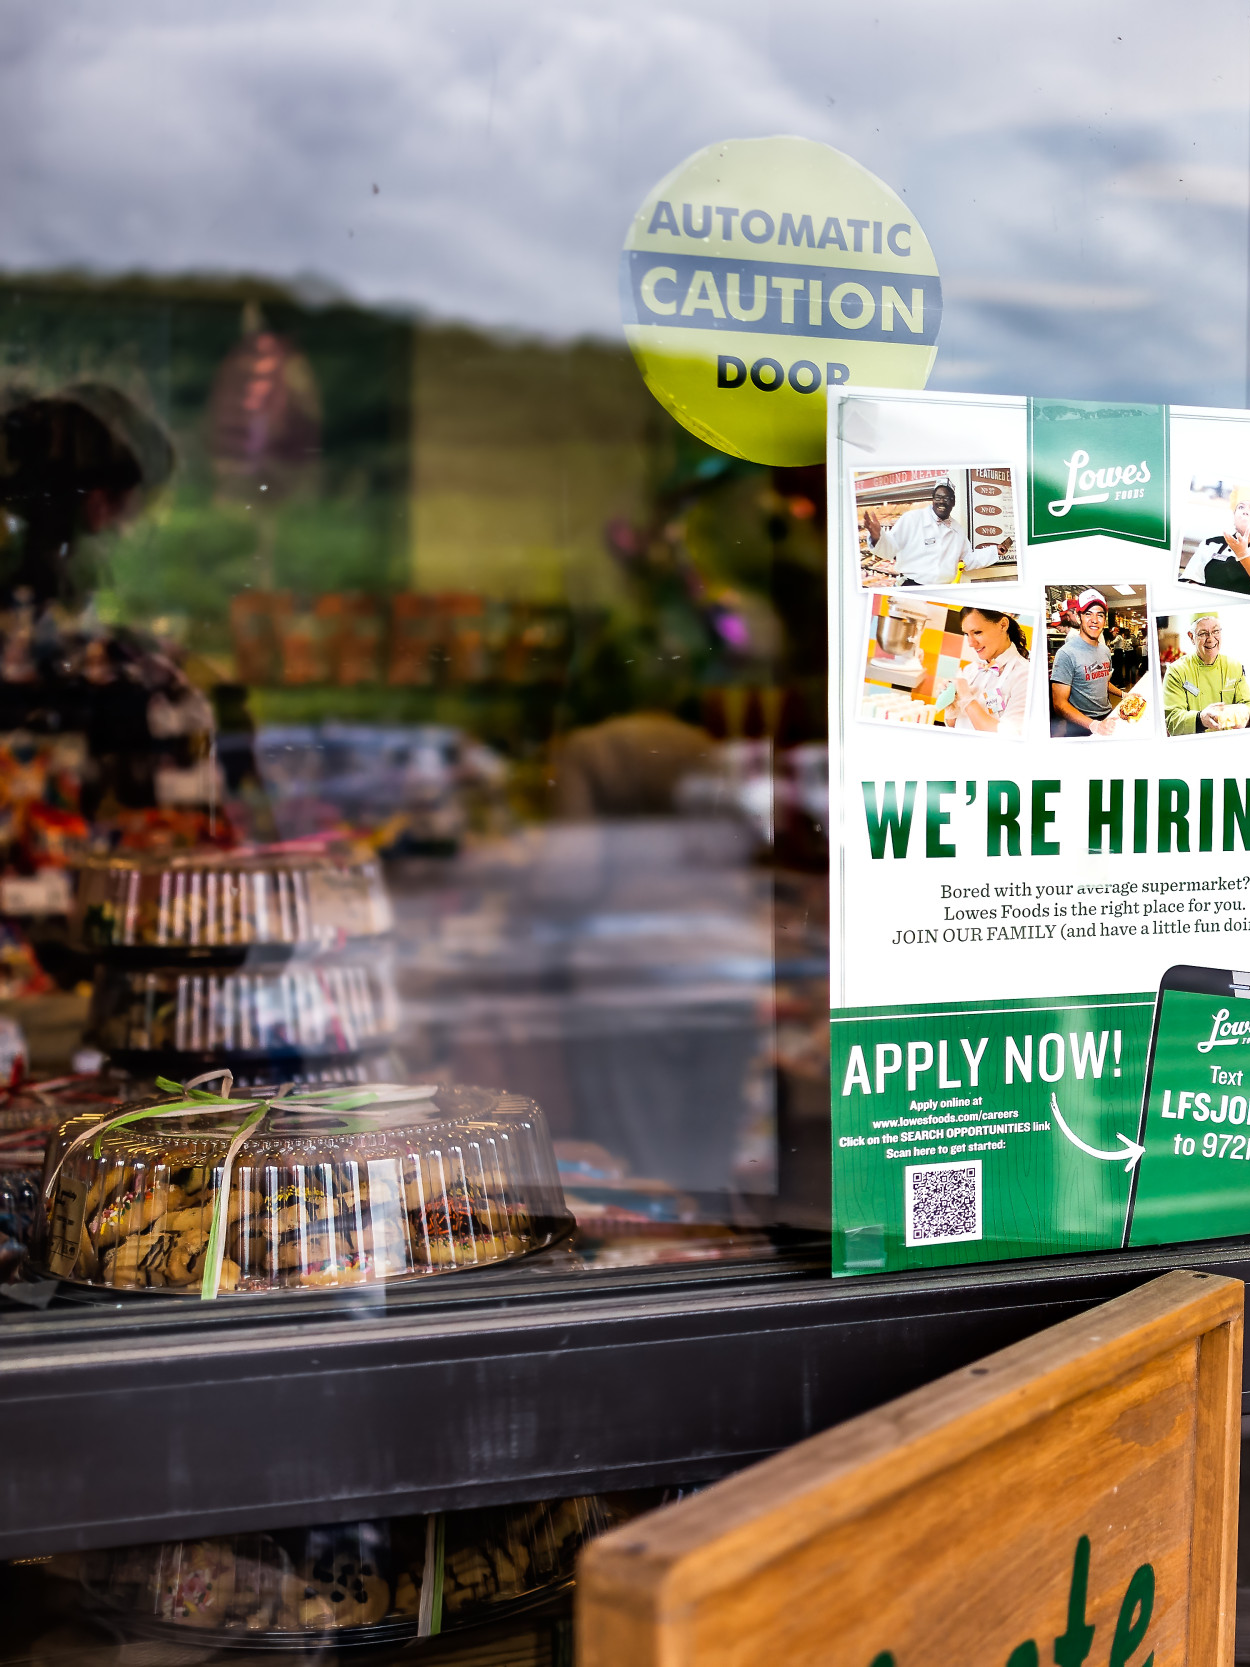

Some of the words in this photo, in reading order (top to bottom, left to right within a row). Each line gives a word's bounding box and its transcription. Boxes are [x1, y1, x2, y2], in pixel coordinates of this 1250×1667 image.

[647, 200, 912, 258] AUTOMATIC
[640, 266, 924, 334] CAUTION
[873, 472, 908, 487] GROUND
[1047, 449, 1151, 518] Lowes
[1114, 488, 1145, 501] FOODS
[861, 779, 1062, 860] WE'RE
[940, 883, 991, 899] Bored
[994, 882, 1032, 897] with
[1035, 884, 1074, 900] your
[1077, 881, 1139, 897] average
[1141, 876, 1250, 895] supermarket?
[944, 906, 997, 921] Lowes
[1001, 903, 1050, 919] Foods
[1053, 902, 1067, 917] is
[1071, 901, 1097, 917] the
[1101, 900, 1140, 918] right
[1143, 900, 1185, 917] place
[1188, 898, 1211, 913] for
[1213, 900, 1246, 914] you.
[892, 928, 939, 945] JOIN
[943, 927, 983, 943] OUR
[986, 924, 1057, 941] FAMILY
[1060, 922, 1097, 940] (and
[1100, 922, 1137, 937] have
[1141, 924, 1150, 935] a
[1152, 919, 1191, 935] little
[1194, 918, 1220, 933] fun
[842, 1037, 990, 1096] APPLY
[1004, 1029, 1123, 1085] NOW!
[1210, 1065, 1244, 1087] Text
[909, 1098, 938, 1112] Apply
[940, 1097, 971, 1108] online
[972, 1096, 983, 1106] at
[872, 1109, 1019, 1129] www.lowesfoods.com/careers
[839, 1135, 866, 1148] Click
[867, 1136, 880, 1146] on
[882, 1133, 899, 1144] the
[900, 1128, 945, 1143] SEARCH
[946, 1121, 1031, 1139] OPPORTUNITIES
[1032, 1120, 1051, 1132] link
[1173, 1133, 1196, 1156] to
[886, 1148, 912, 1159] Scan
[913, 1146, 936, 1157] here
[937, 1145, 948, 1155] to
[950, 1143, 966, 1156] get
[967, 1139, 1006, 1152] started:
